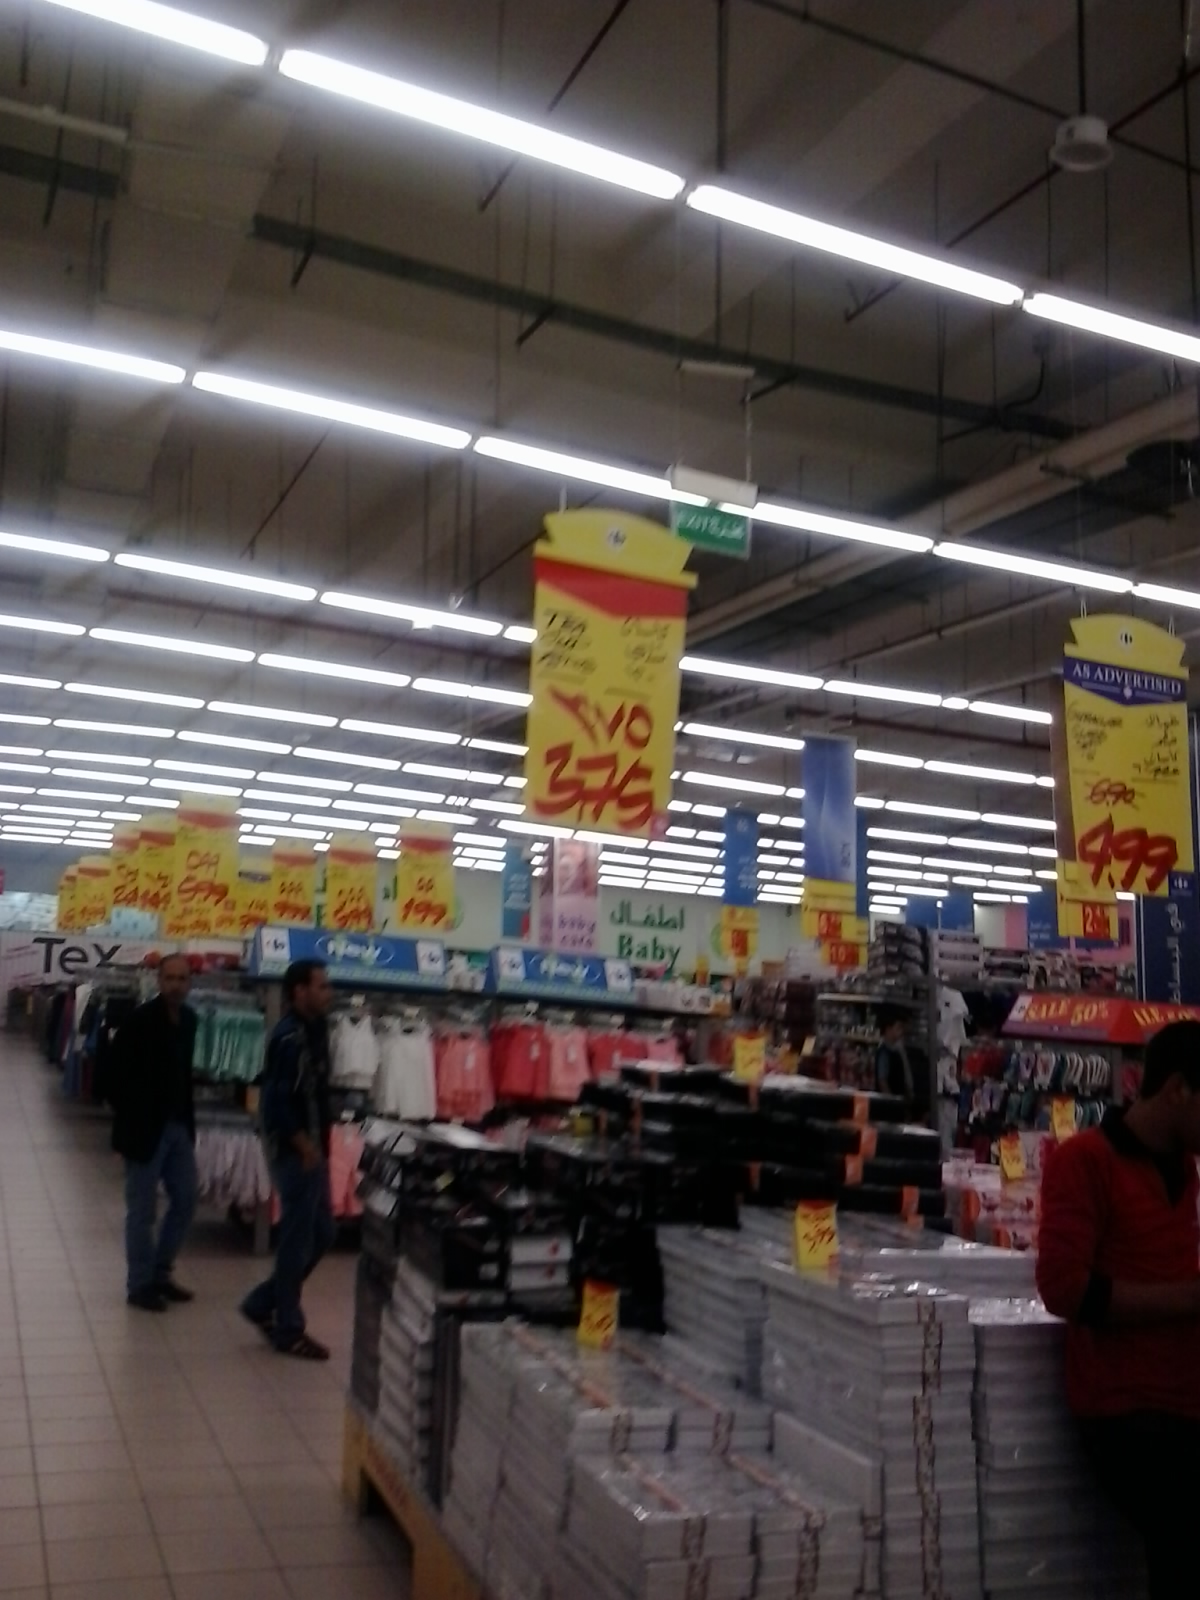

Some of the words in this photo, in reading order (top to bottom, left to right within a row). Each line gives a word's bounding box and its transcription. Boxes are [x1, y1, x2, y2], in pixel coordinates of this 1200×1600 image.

[1072, 661, 1090, 680] AS
[1093, 665, 1182, 696] ADVERTISED
[32, 936, 123, 974] Tex
[618, 933, 681, 982] Baby
